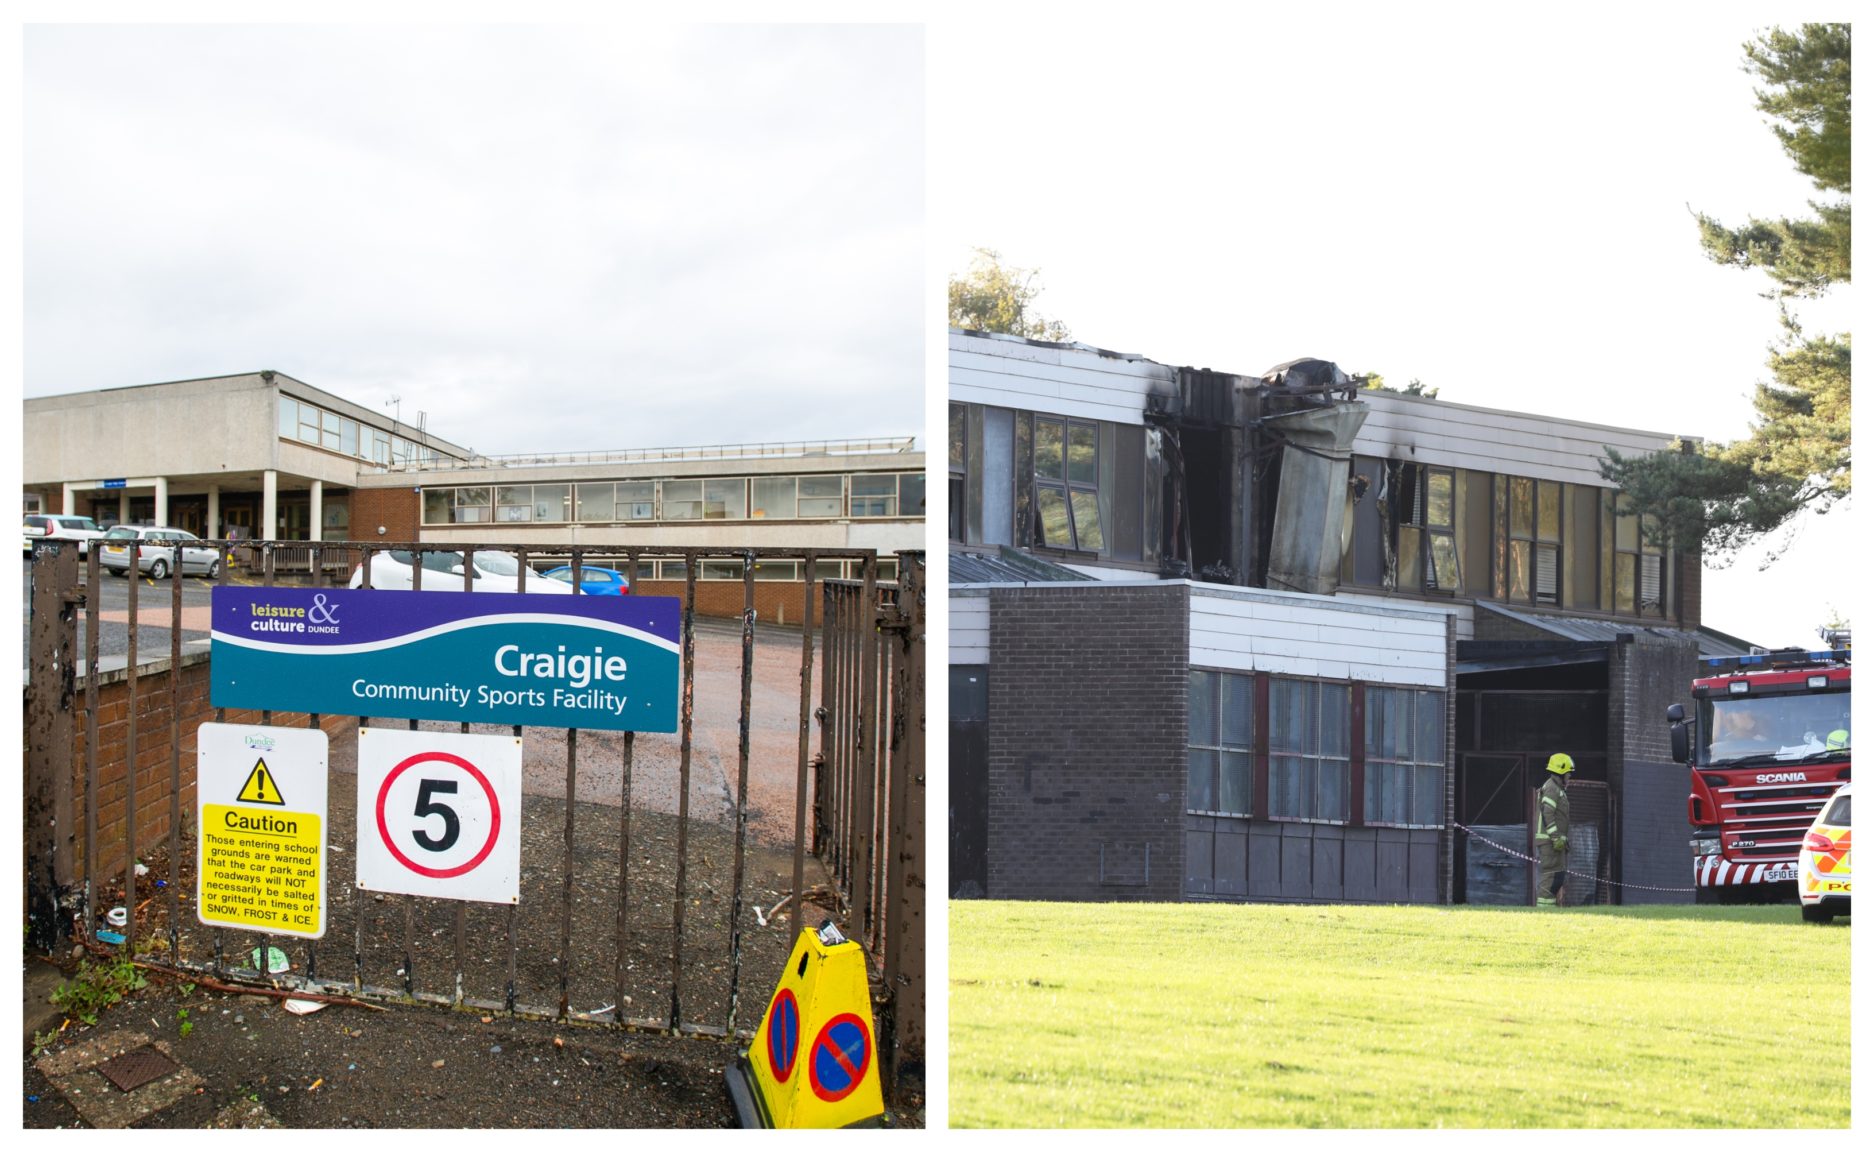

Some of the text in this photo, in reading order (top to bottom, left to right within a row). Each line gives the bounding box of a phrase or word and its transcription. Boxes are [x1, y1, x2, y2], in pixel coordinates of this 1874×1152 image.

[251, 593, 340, 624] leisure &
[251, 618, 340, 633] culture DUNDEE
[494, 645, 627, 688] Craigie
[352, 679, 627, 715] Community Sports Facility
[1756, 772, 1807, 784] SCANIA
[224, 811, 297, 834] Caution
[412, 779, 460, 852] 5
[206, 834, 318, 854] Those entering school
[211, 848, 311, 865] grounds are warned
[207, 858, 316, 878] that the car park and
[214, 871, 306, 888] roadways will NOT
[206, 881, 315, 901] necessarily be salted
[207, 892, 314, 912] or gritted in times of
[244, 908, 277, 920] FROST
[282, 913, 289, 922] &
[293, 915, 314, 926] ICE.
